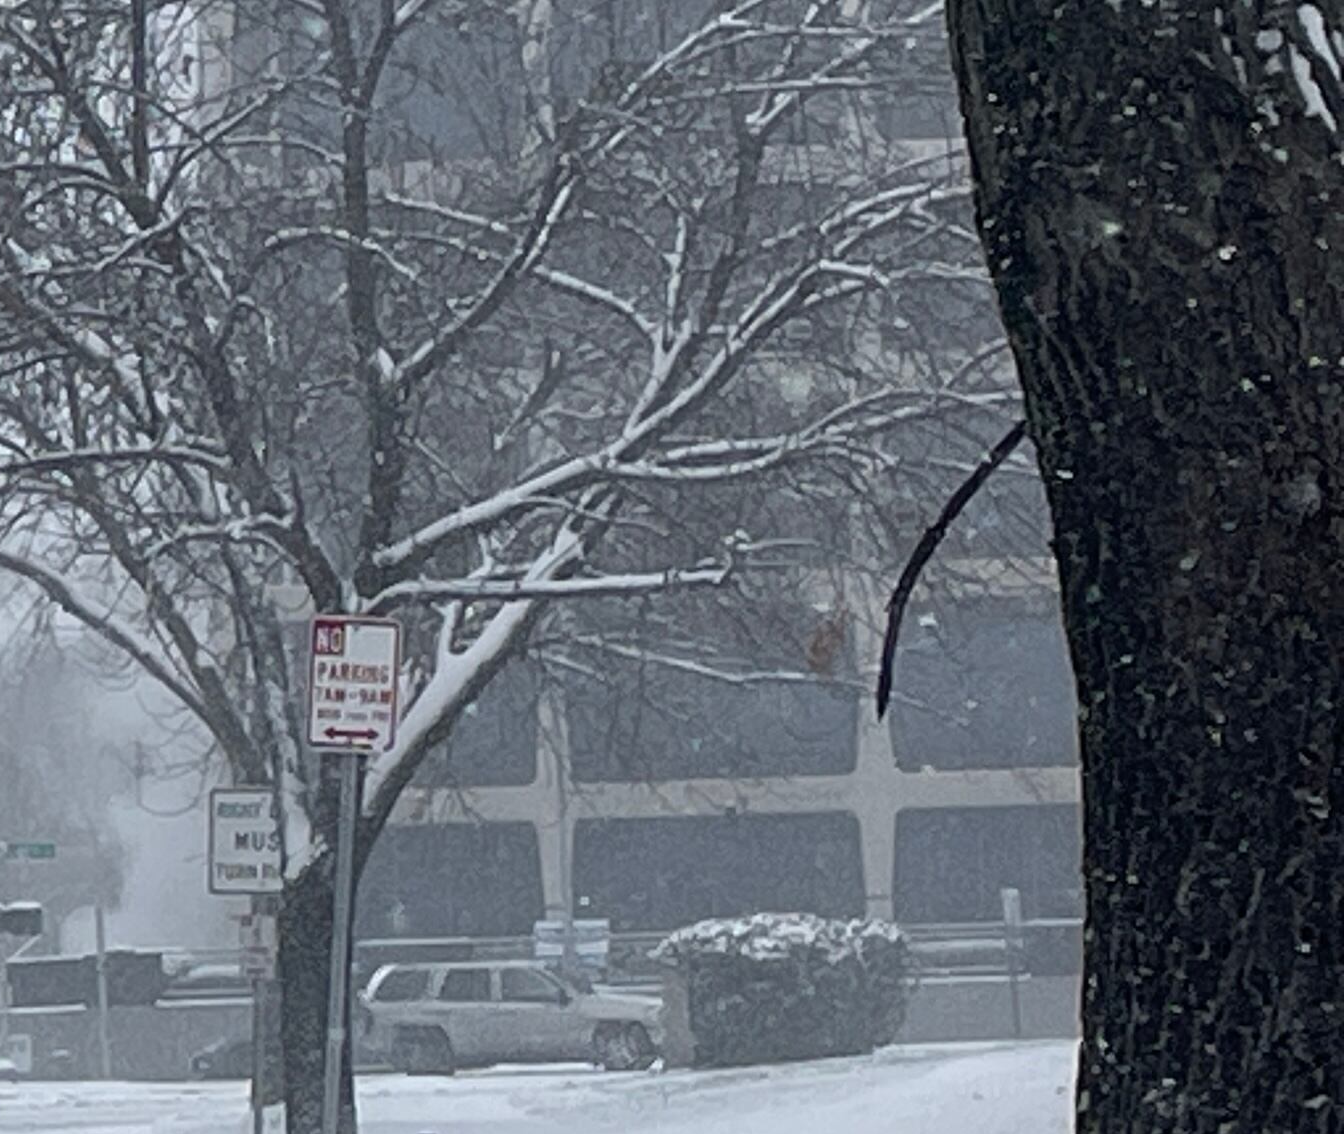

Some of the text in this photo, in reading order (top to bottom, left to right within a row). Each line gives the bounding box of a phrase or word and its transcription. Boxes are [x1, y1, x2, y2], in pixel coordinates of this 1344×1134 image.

[316, 626, 343, 653] NO
[317, 661, 390, 684] PARKING
[234, 831, 282, 852] MUS
